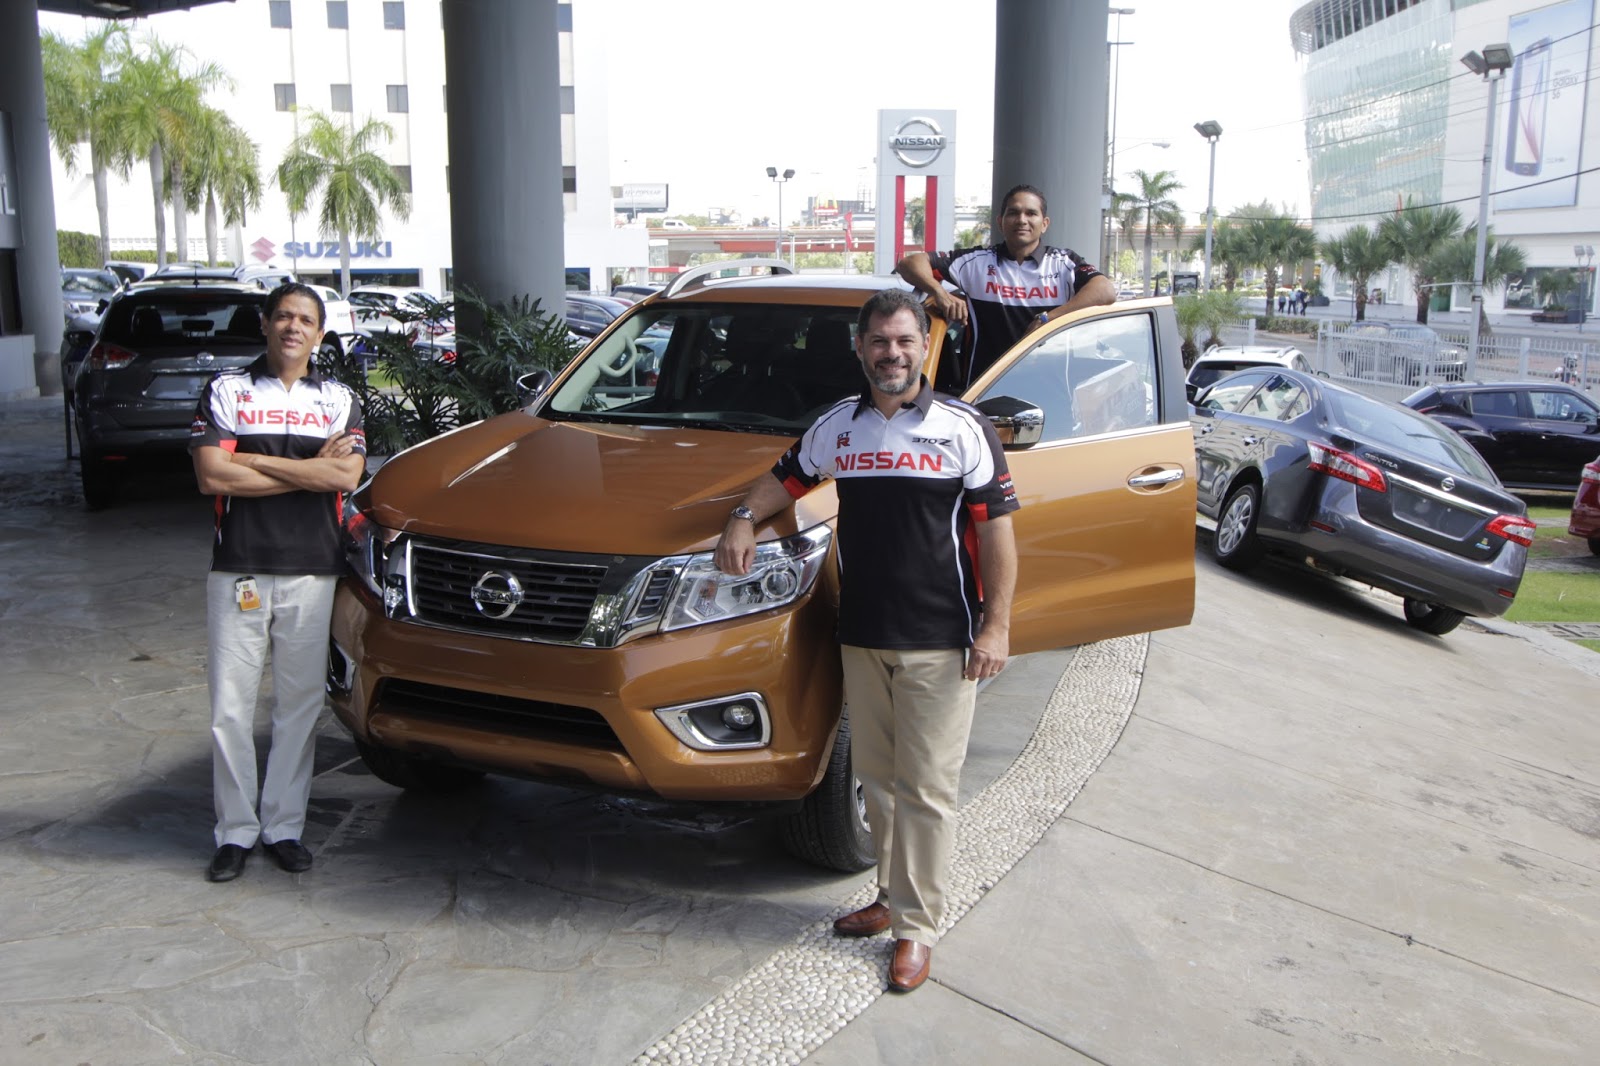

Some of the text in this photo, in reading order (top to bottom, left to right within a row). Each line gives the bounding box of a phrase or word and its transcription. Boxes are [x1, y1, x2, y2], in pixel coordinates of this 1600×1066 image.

[1552, 75, 1579, 87] Galaxy
[1552, 89, 1561, 100] S6
[895, 138, 941, 146] NISSAN
[283, 241, 392, 258] SUZUKI
[912, 437, 952, 447] 370Z
[835, 451, 942, 472] NISSAN
[1365, 452, 1398, 470] SENTRA
